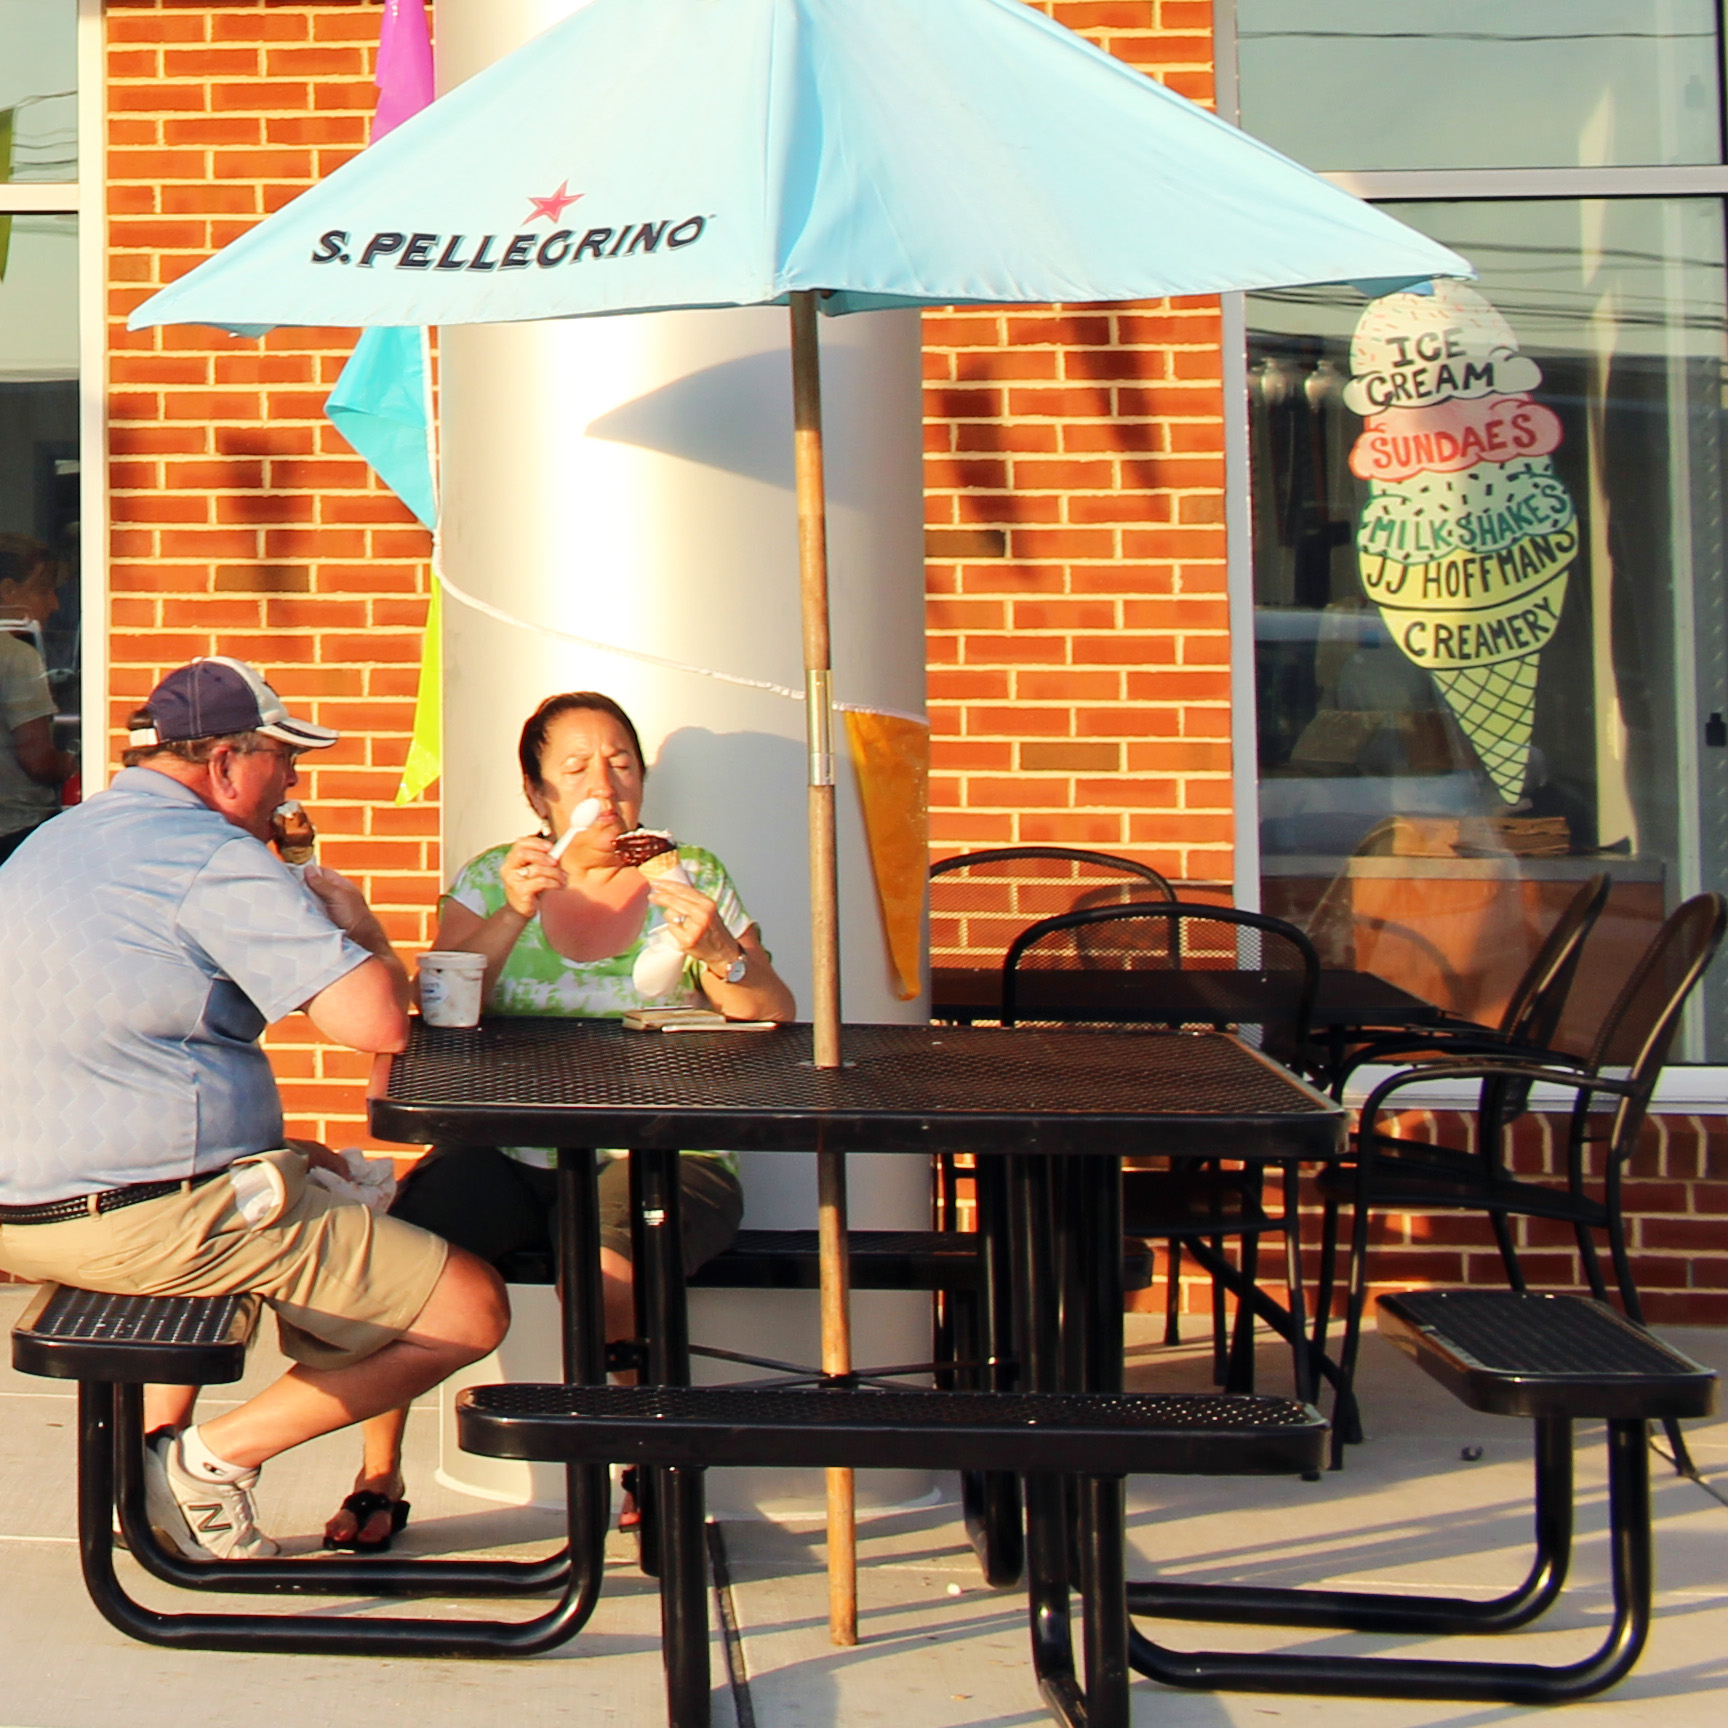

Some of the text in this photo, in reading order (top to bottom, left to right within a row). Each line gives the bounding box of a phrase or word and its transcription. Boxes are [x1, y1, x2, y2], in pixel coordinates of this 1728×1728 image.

[1386, 328, 1467, 367] ICE
[1365, 362, 1494, 406] CREAM
[1370, 413, 1537, 470] SUNDAES
[1367, 556, 1407, 595] JJ
[1404, 597, 1560, 661] CREAMERY
